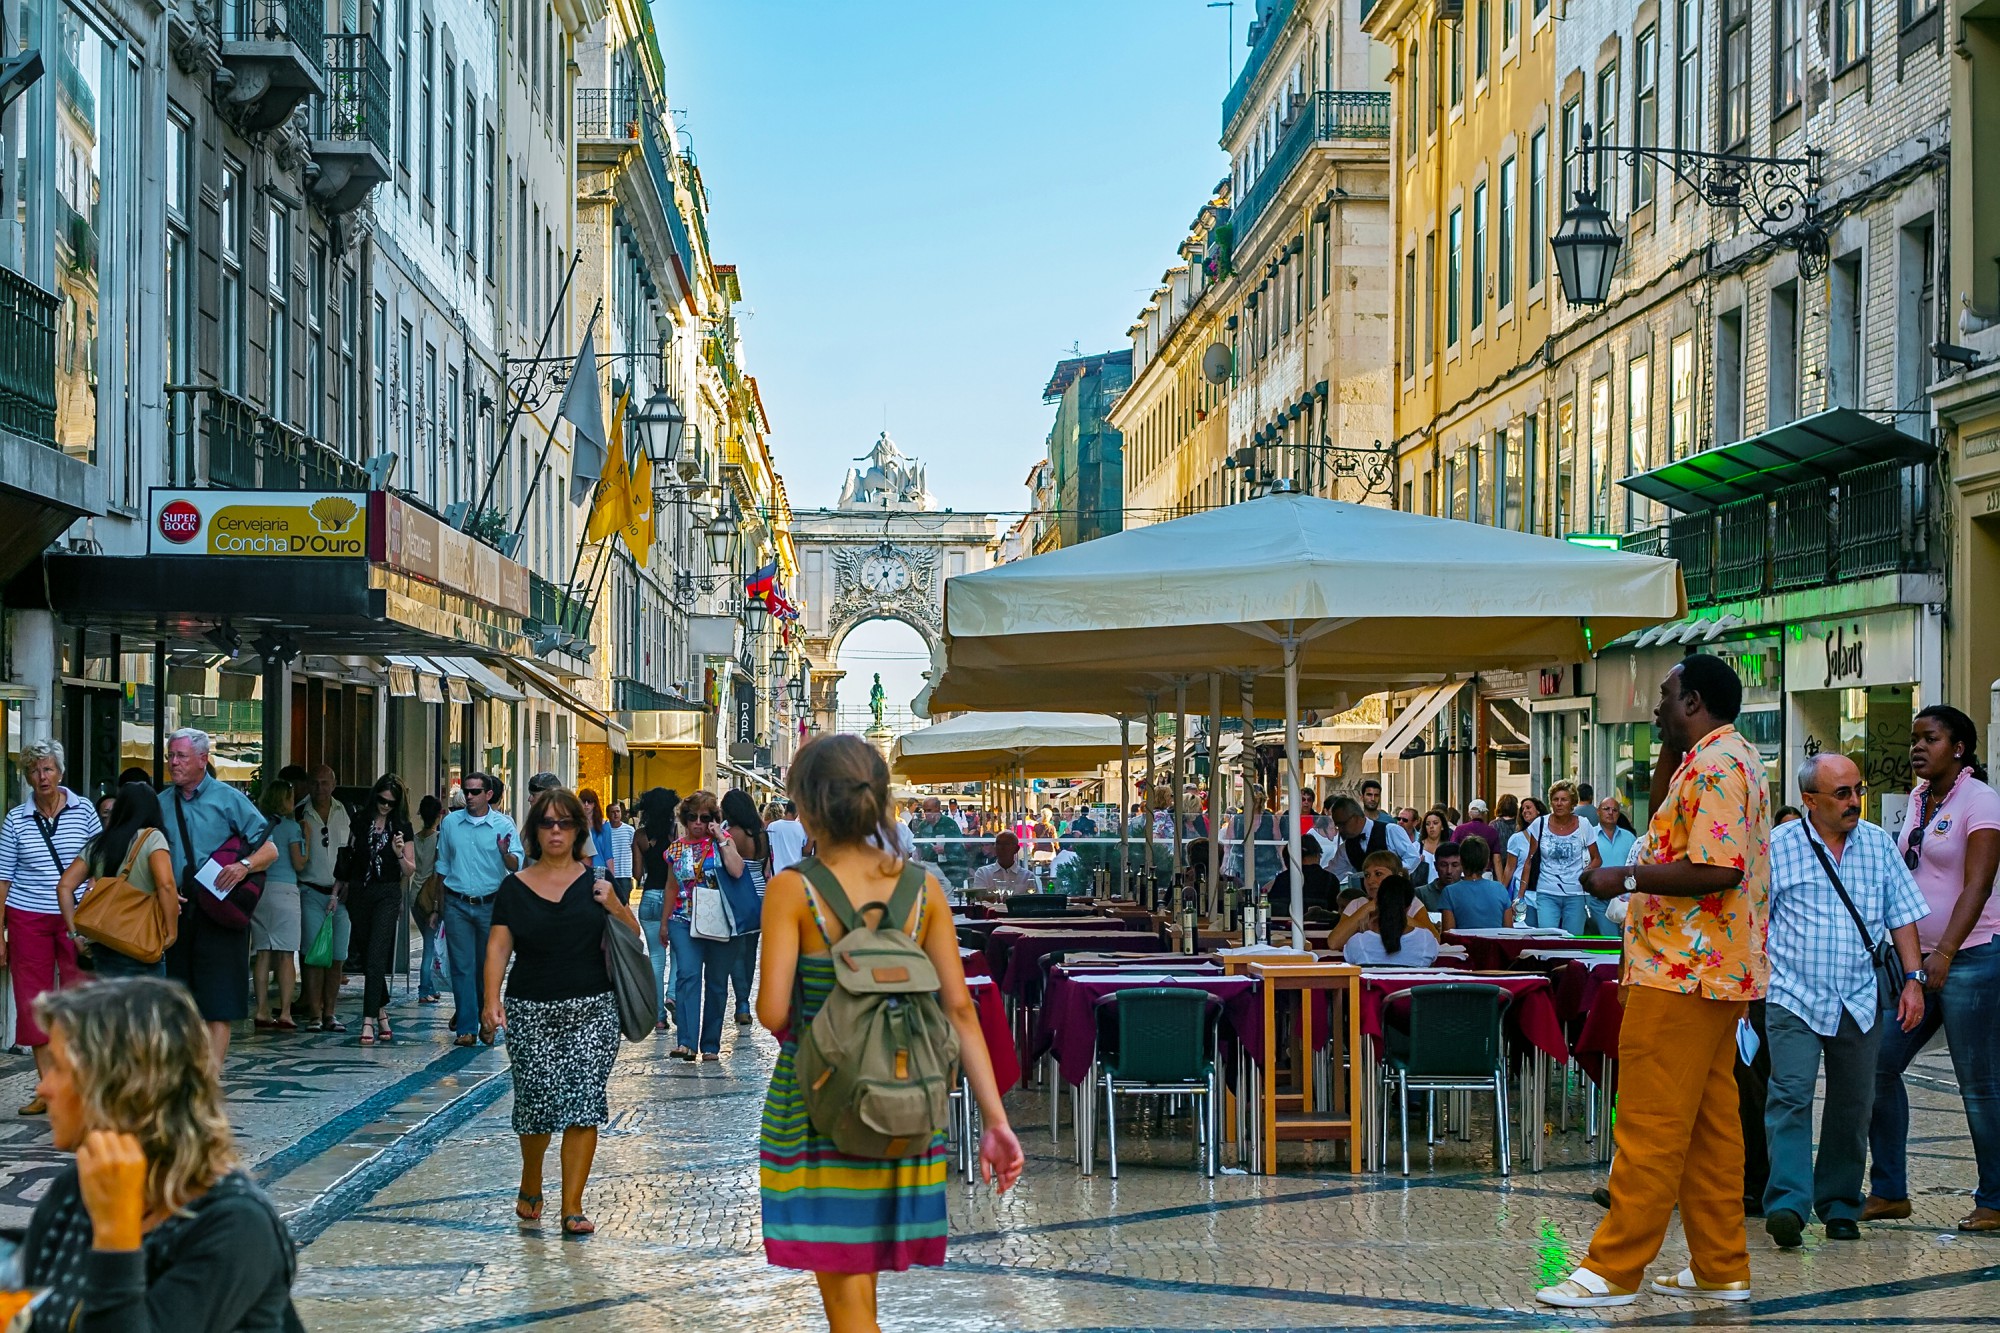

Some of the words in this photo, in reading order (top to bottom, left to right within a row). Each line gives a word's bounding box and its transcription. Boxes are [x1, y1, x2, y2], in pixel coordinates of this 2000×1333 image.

[163, 512, 197, 522] SUPER
[217, 516, 289, 533] Cervejaria
[164, 522, 195, 531] BOCK
[215, 533, 287, 552] Concha
[290, 535, 361, 553] D'Ouro
[716, 599, 745, 613] OTEL
[1824, 624, 1862, 688] Solaris
